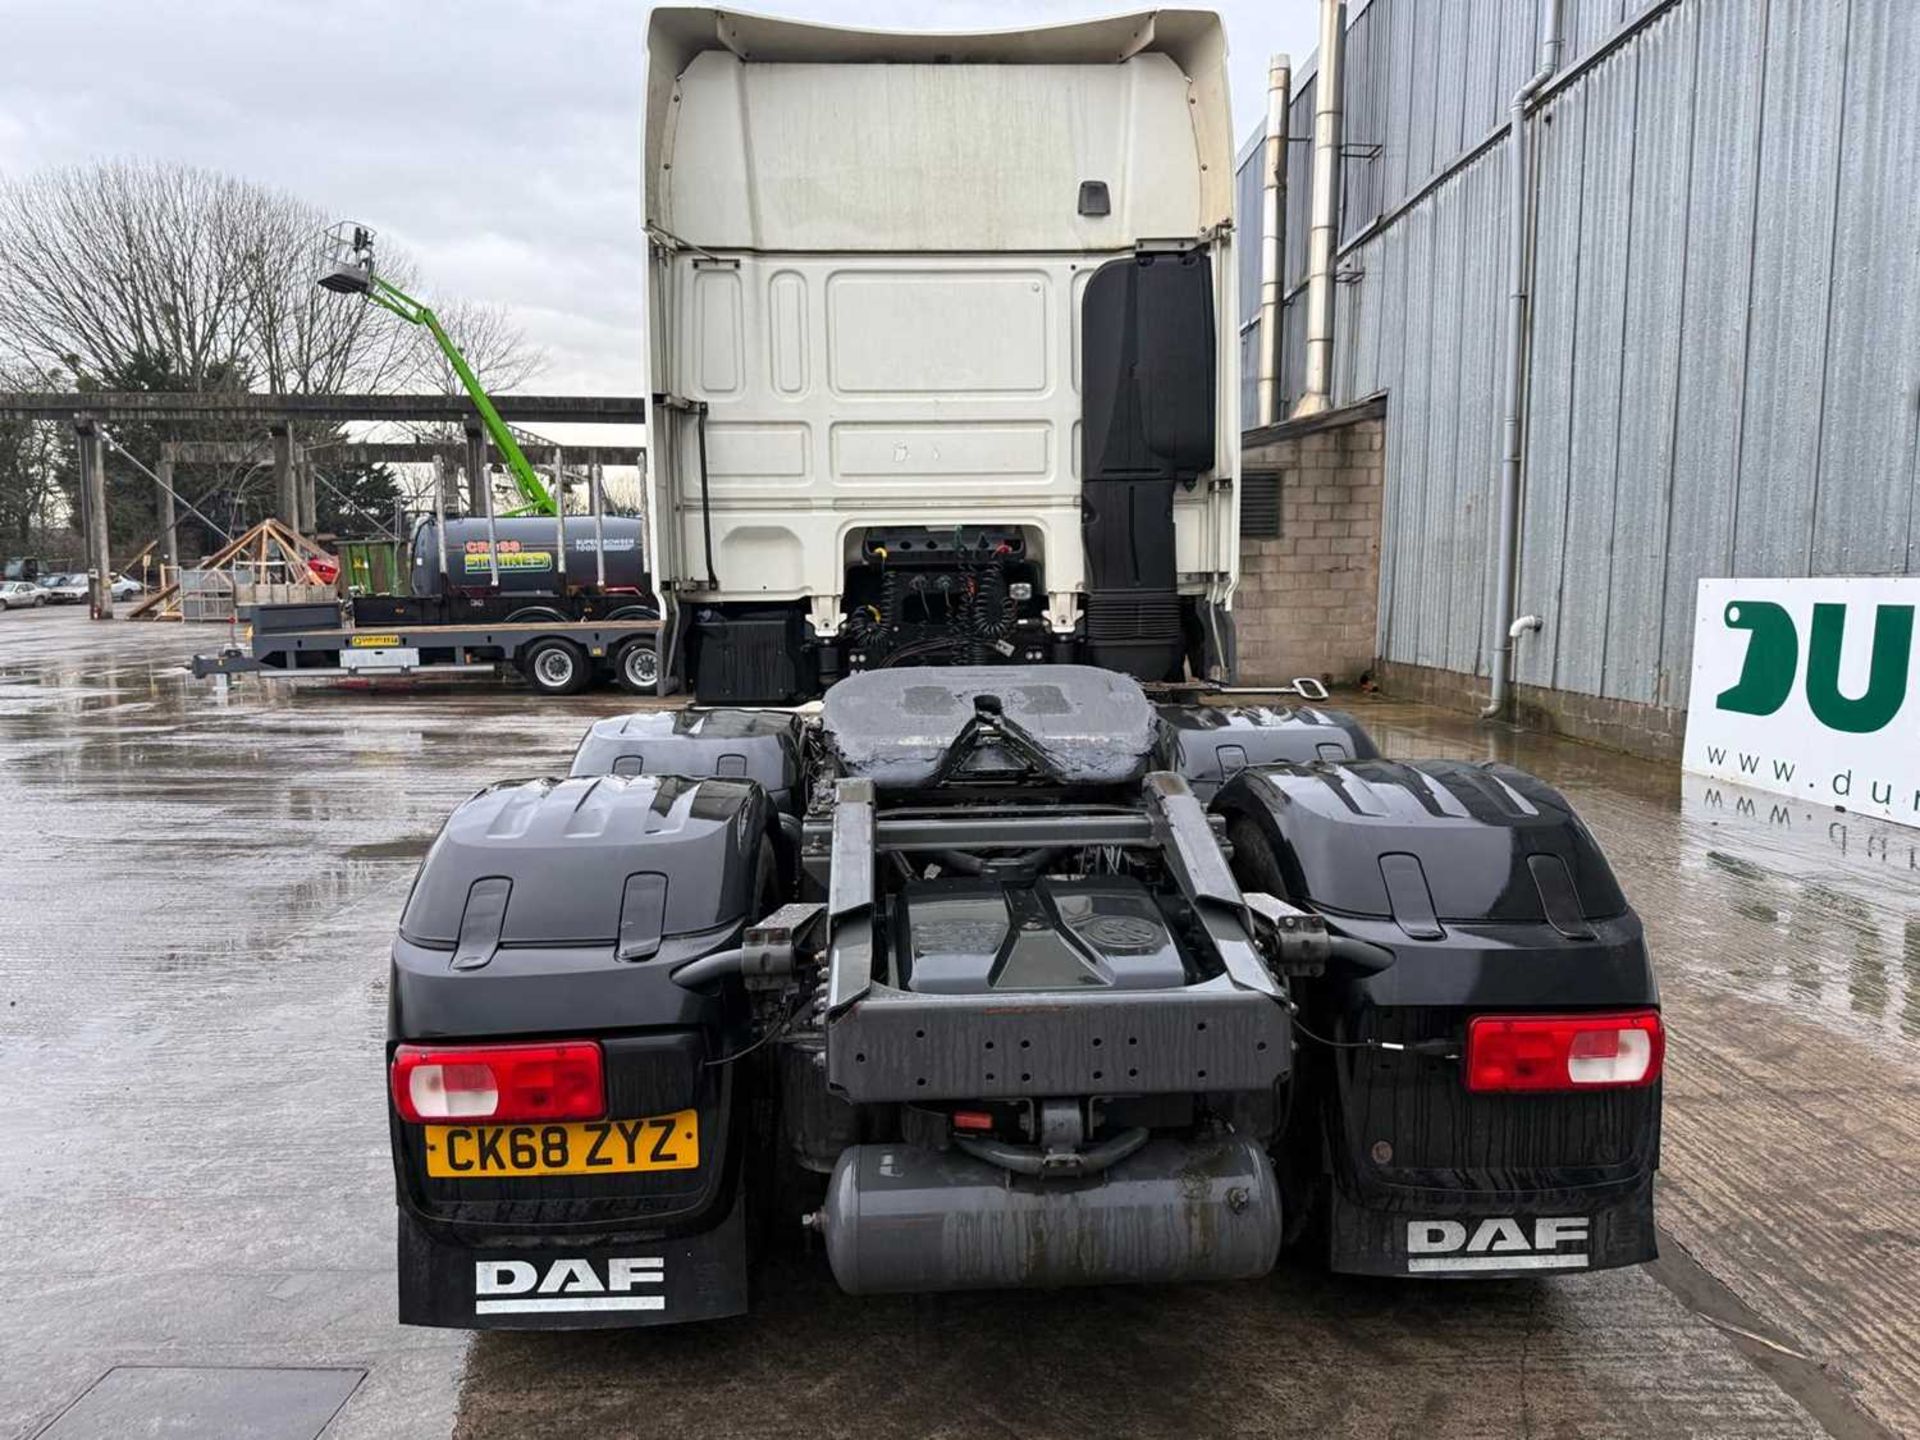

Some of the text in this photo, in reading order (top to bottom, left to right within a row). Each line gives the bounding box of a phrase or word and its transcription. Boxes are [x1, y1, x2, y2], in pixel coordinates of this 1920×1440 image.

[446, 1119, 678, 1171] CK68 ZYZ
[1407, 1217, 1590, 1253] DAF
[475, 1257, 664, 1295] DAF
